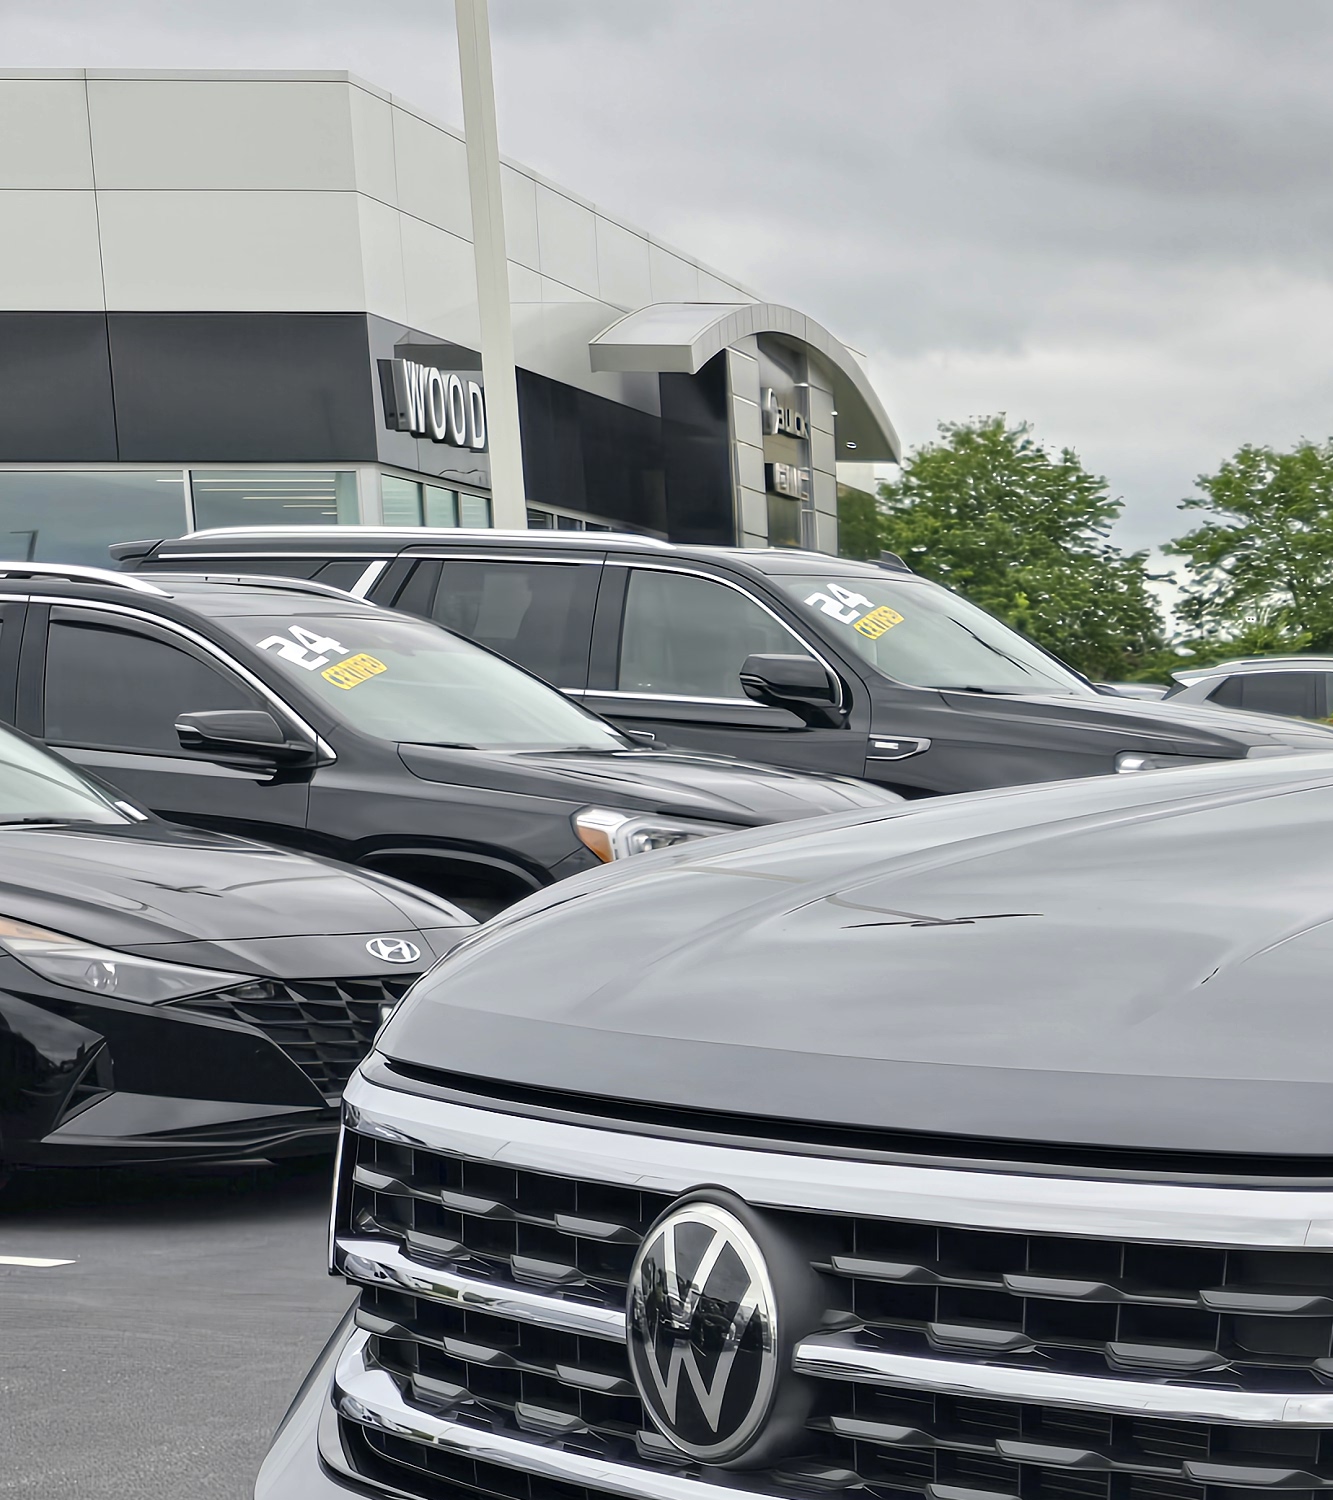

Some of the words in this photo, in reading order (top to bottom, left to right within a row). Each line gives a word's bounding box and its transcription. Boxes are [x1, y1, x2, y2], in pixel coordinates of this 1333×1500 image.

[393, 358, 487, 450] WOOD
[803, 583, 875, 625] 24
[256, 625, 350, 671] 24
